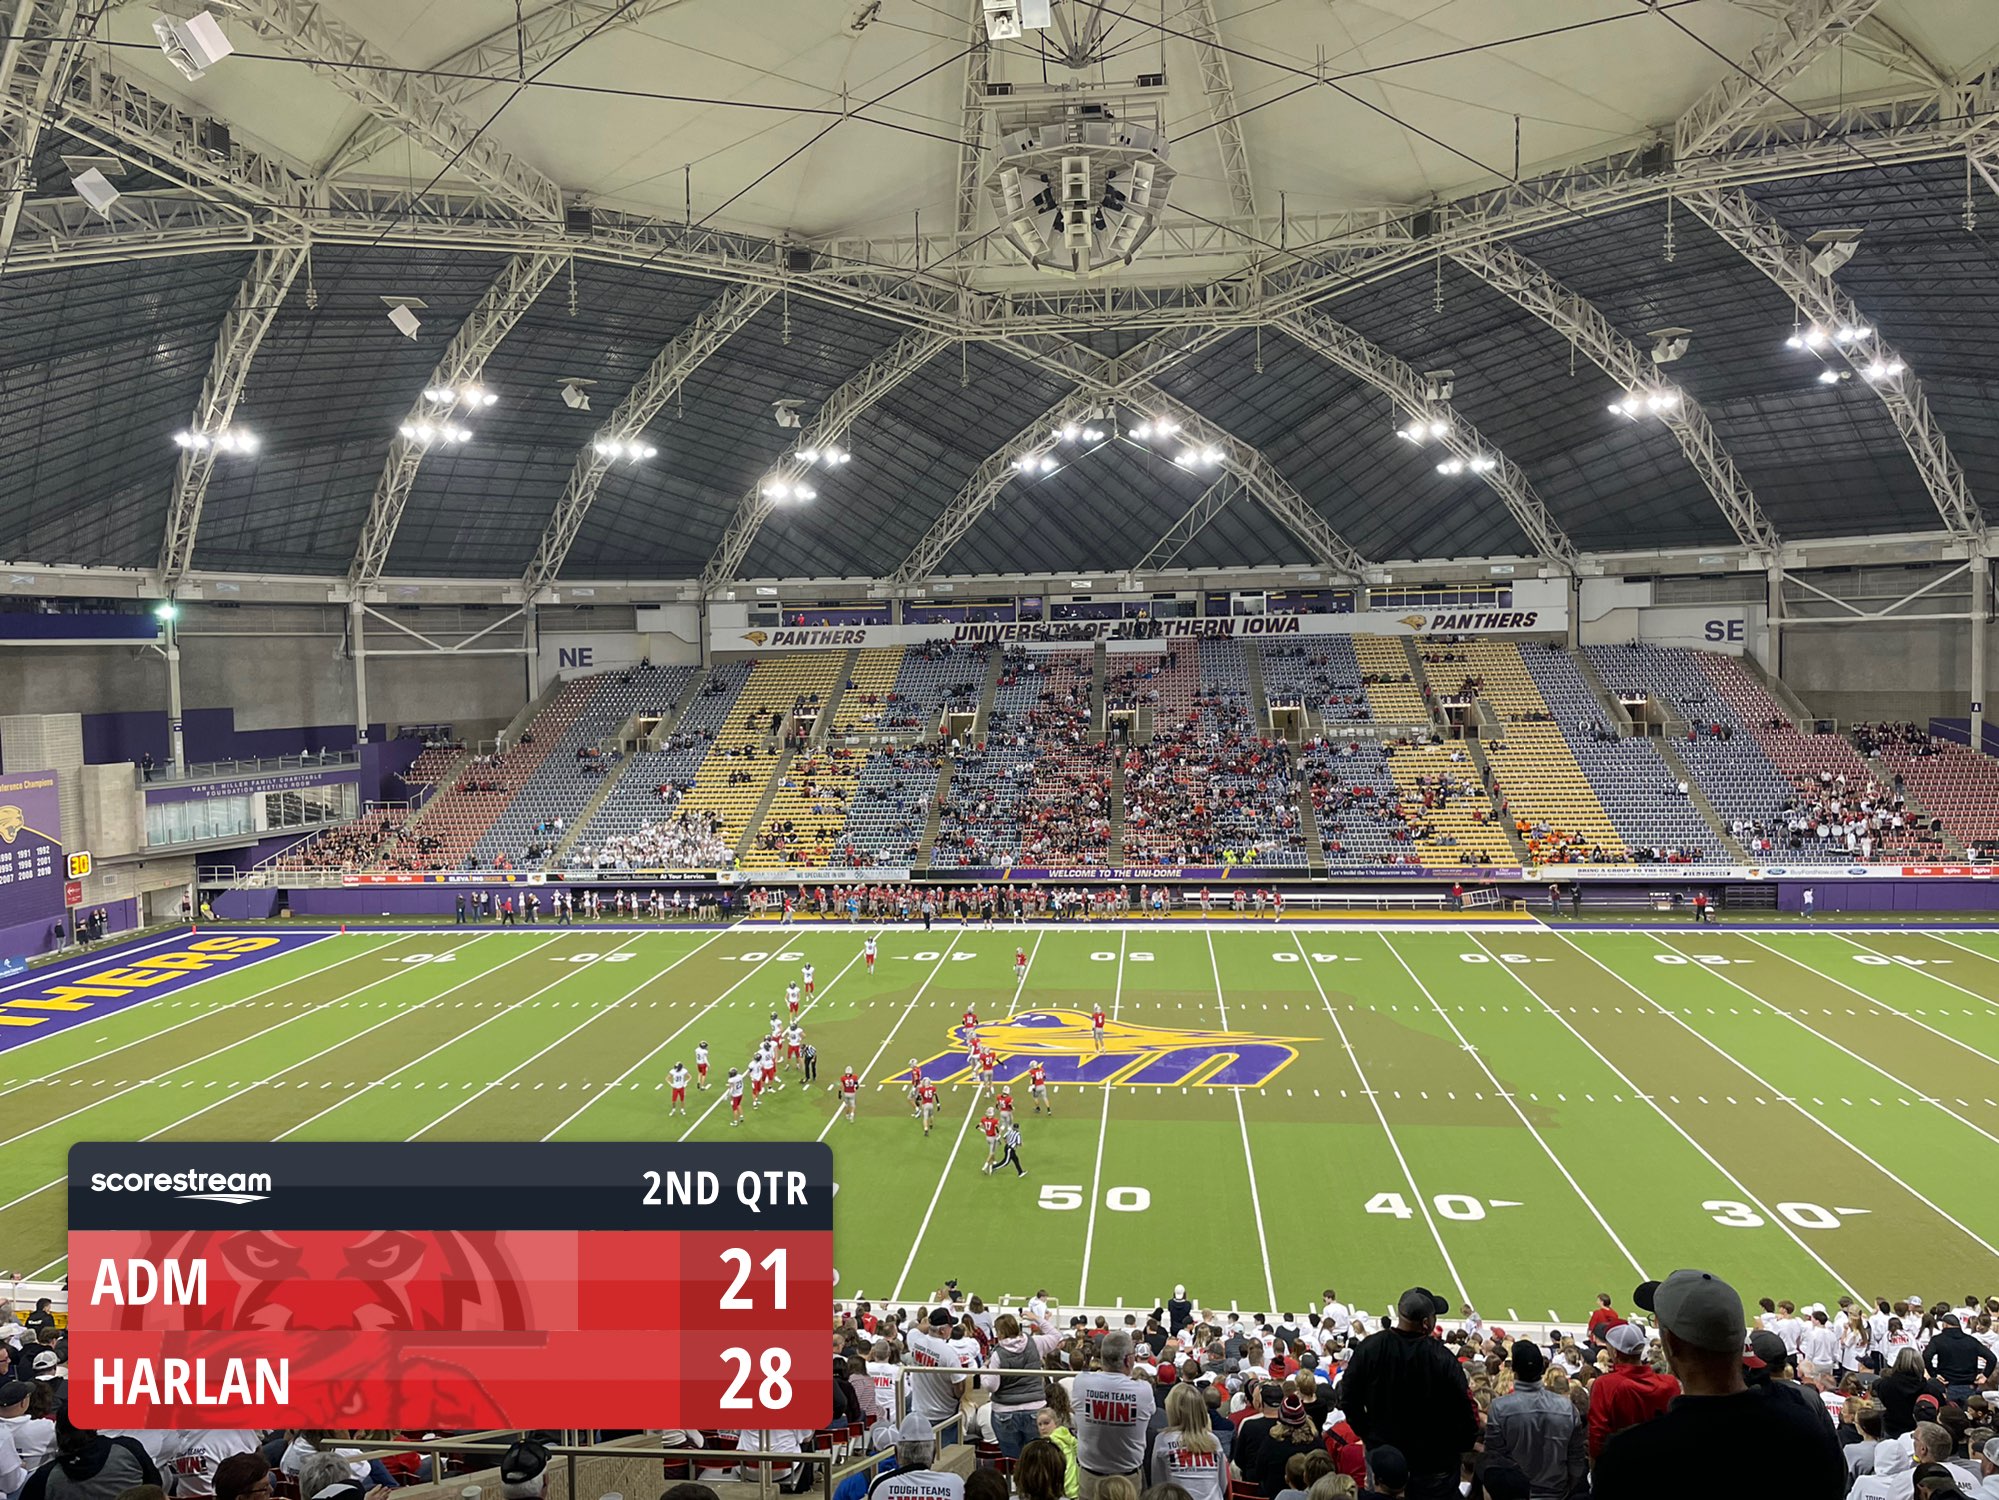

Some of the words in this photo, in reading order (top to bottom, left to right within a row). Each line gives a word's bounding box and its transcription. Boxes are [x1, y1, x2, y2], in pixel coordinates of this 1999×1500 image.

[1430, 612, 1539, 630] PANTHERS
[1080, 622, 1111, 639] OF
[1241, 617, 1300, 634] IOWA
[1704, 619, 1744, 642] SE
[771, 630, 867, 646] PANTHERS
[559, 647, 593, 668] NE
[23, 778, 54, 789] Champions
[251, 778, 276, 786] FAMILY
[279, 774, 322, 783] CHARITABLE
[206, 787, 254, 797] FOUNDATION
[257, 782, 288, 791] MEETING
[17, 848, 31, 859] 1991
[36, 845, 50, 855] 1992
[37, 856, 51, 866] 2001
[71, 855, 89, 875] 30
[1049, 869, 1096, 878] WELCOME
[1099, 869, 1112, 878] TO
[1113, 869, 1132, 878] THE
[1134, 869, 1182, 878] UNI-DOME
[739, 952, 805, 962] 30
[913, 952, 977, 962] 40
[1091, 951, 1155, 962] 50
[1272, 952, 1338, 963] 40
[1459, 953, 1533, 963] 30
[1037, 1185, 1151, 1212] 50
[1364, 1192, 1486, 1221] 40
[1701, 1200, 1841, 1229] 30
[914, 1349, 936, 1367] WIN
[926, 1347, 940, 1359] TEAMS
[873, 1376, 889, 1387] WIN
[1086, 1389, 1110, 1400] TOUGH
[1112, 1392, 1137, 1402] TEAMS
[1092, 1400, 1130, 1422] WIN
[176, 1457, 201, 1475] WIN
[889, 1485, 918, 1495] TOUGH
[920, 1486, 951, 1497] TEAMS
[1957, 1481, 1973, 1491] AMS
